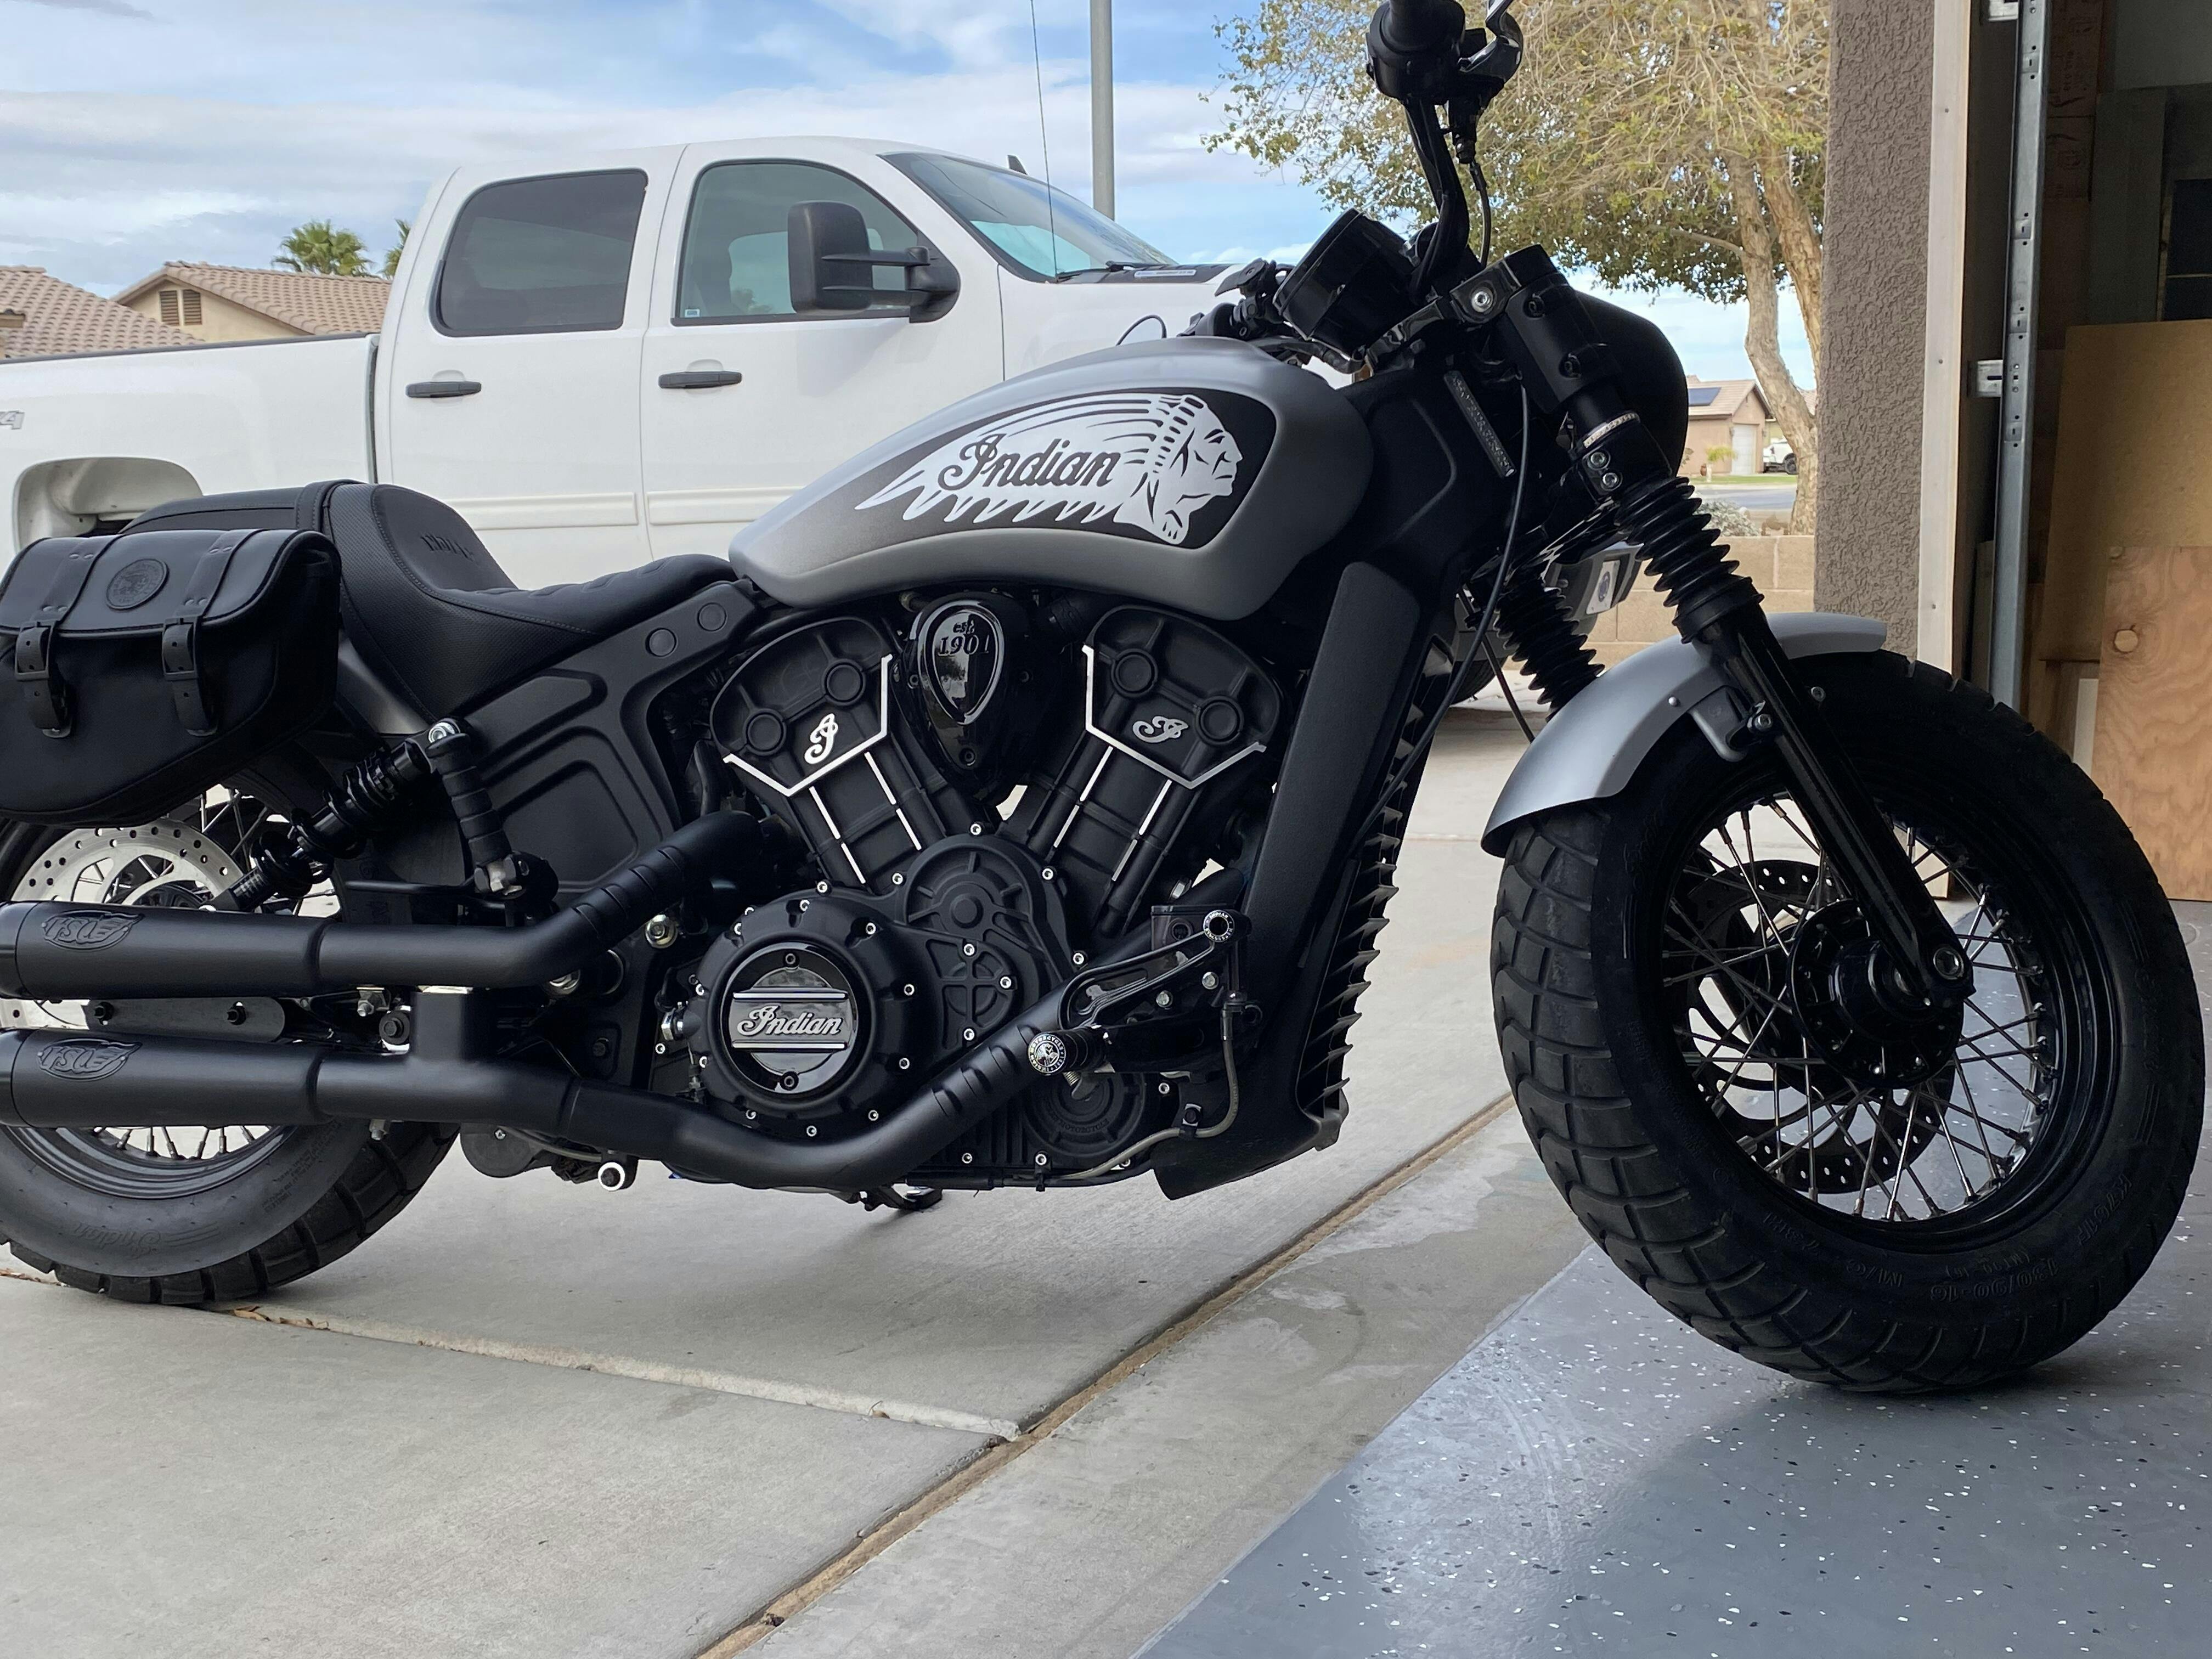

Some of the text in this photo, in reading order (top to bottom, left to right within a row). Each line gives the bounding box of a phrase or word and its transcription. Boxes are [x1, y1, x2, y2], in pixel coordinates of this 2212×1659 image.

[938, 434, 1121, 490] Indian
[938, 635, 990, 657] 1901
[737, 1003, 843, 1036] Indian
[1030, 1035, 1064, 1052] MOTORCYCLE
[72, 1222, 162, 1261] Indian
[1930, 1257, 2058, 1303] 130/90-16
